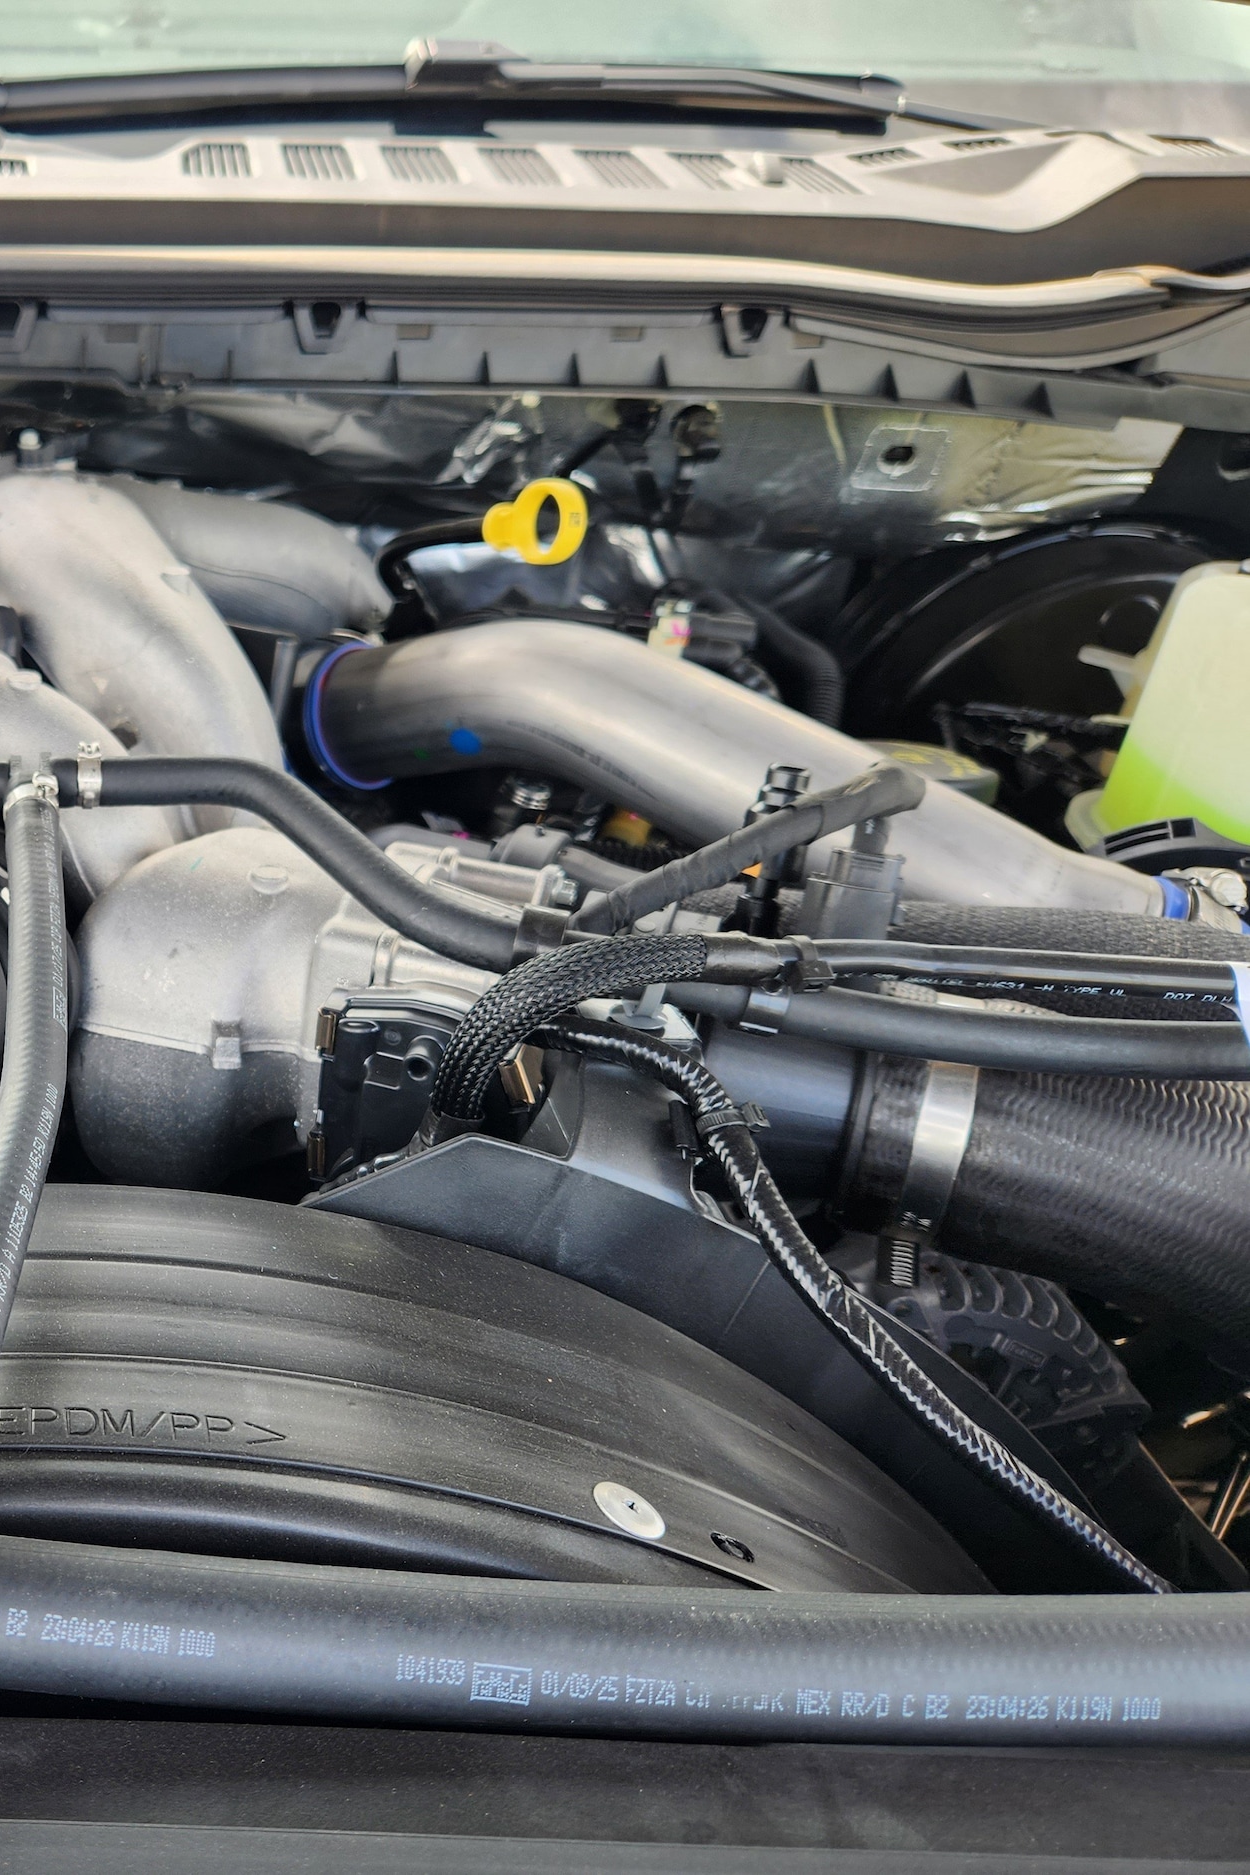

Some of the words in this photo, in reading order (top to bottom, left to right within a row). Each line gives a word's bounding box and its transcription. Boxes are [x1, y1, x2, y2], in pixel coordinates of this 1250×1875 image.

[45, 1083, 58, 1109] 1000
[37, 1106, 54, 1140] K119N
[24, 1137, 45, 1187] 14:45:50
[19, 1184, 33, 1203] B2
[2, 1248, 17, 1264] A
[5, 1607, 29, 1636] B2
[41, 1613, 117, 1647] 23:04:26
[120, 1621, 170, 1655] K119N
[178, 1628, 216, 1657] 1000
[396, 1654, 466, 1685] 1041939
[541, 1670, 620, 1702] 01/09/25
[796, 1688, 830, 1715] MEX
[841, 1691, 890, 1718] RR/D
[902, 1694, 915, 1717] C
[925, 1694, 950, 1719] B2
[966, 1694, 1050, 1720] 23:04:26
[1056, 1695, 1112, 1721] K119N
[1122, 1697, 1162, 1722] 1000
